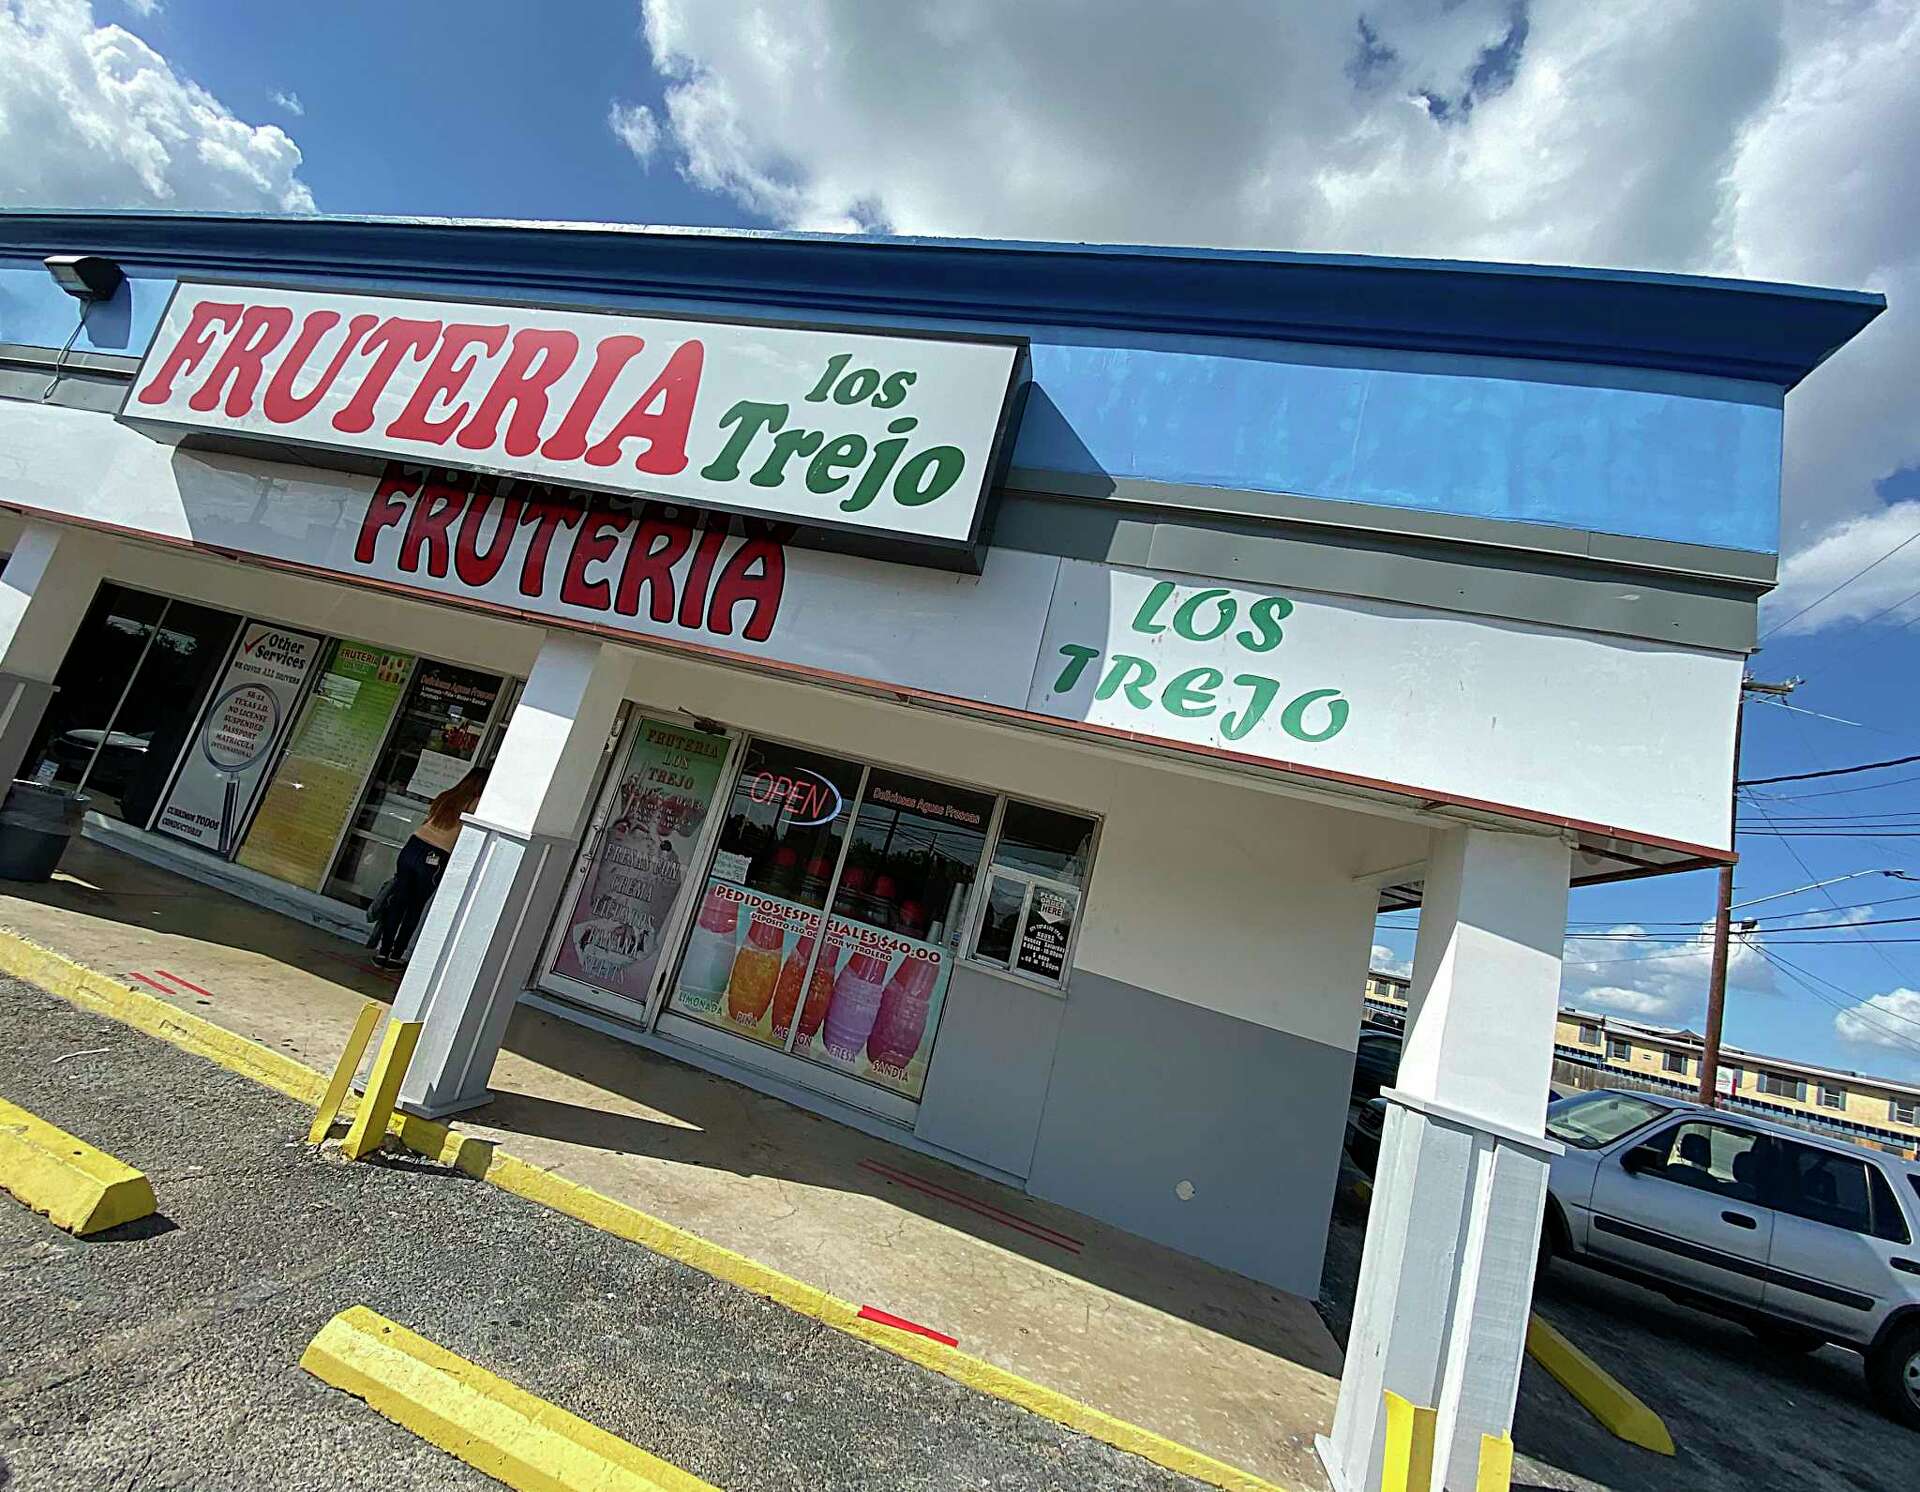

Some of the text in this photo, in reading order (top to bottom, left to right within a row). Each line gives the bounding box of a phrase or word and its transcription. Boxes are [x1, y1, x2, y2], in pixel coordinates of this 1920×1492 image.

[138, 301, 705, 477] FRUTERIA
[804, 352, 919, 409] los
[700, 400, 967, 512] Trejo
[354, 474, 786, 643] FRUTERIA
[1131, 580, 1294, 653] LOS
[255, 644, 306, 670] Services
[269, 633, 305, 655] Other
[648, 728, 720, 759] FRUTERIA
[648, 767, 695, 790] TREJO
[750, 772, 829, 819] OPEN
[715, 884, 783, 915] PEDIDOS
[1042, 903, 1063, 917] HERE
[750, 911, 790, 931] DEPOSITO
[826, 934, 844, 947] POR
[844, 940, 893, 963] VITROLERO
[679, 989, 723, 1017] LIMONADA
[772, 1024, 813, 1048] MEON
[829, 1044, 857, 1065] FRESA
